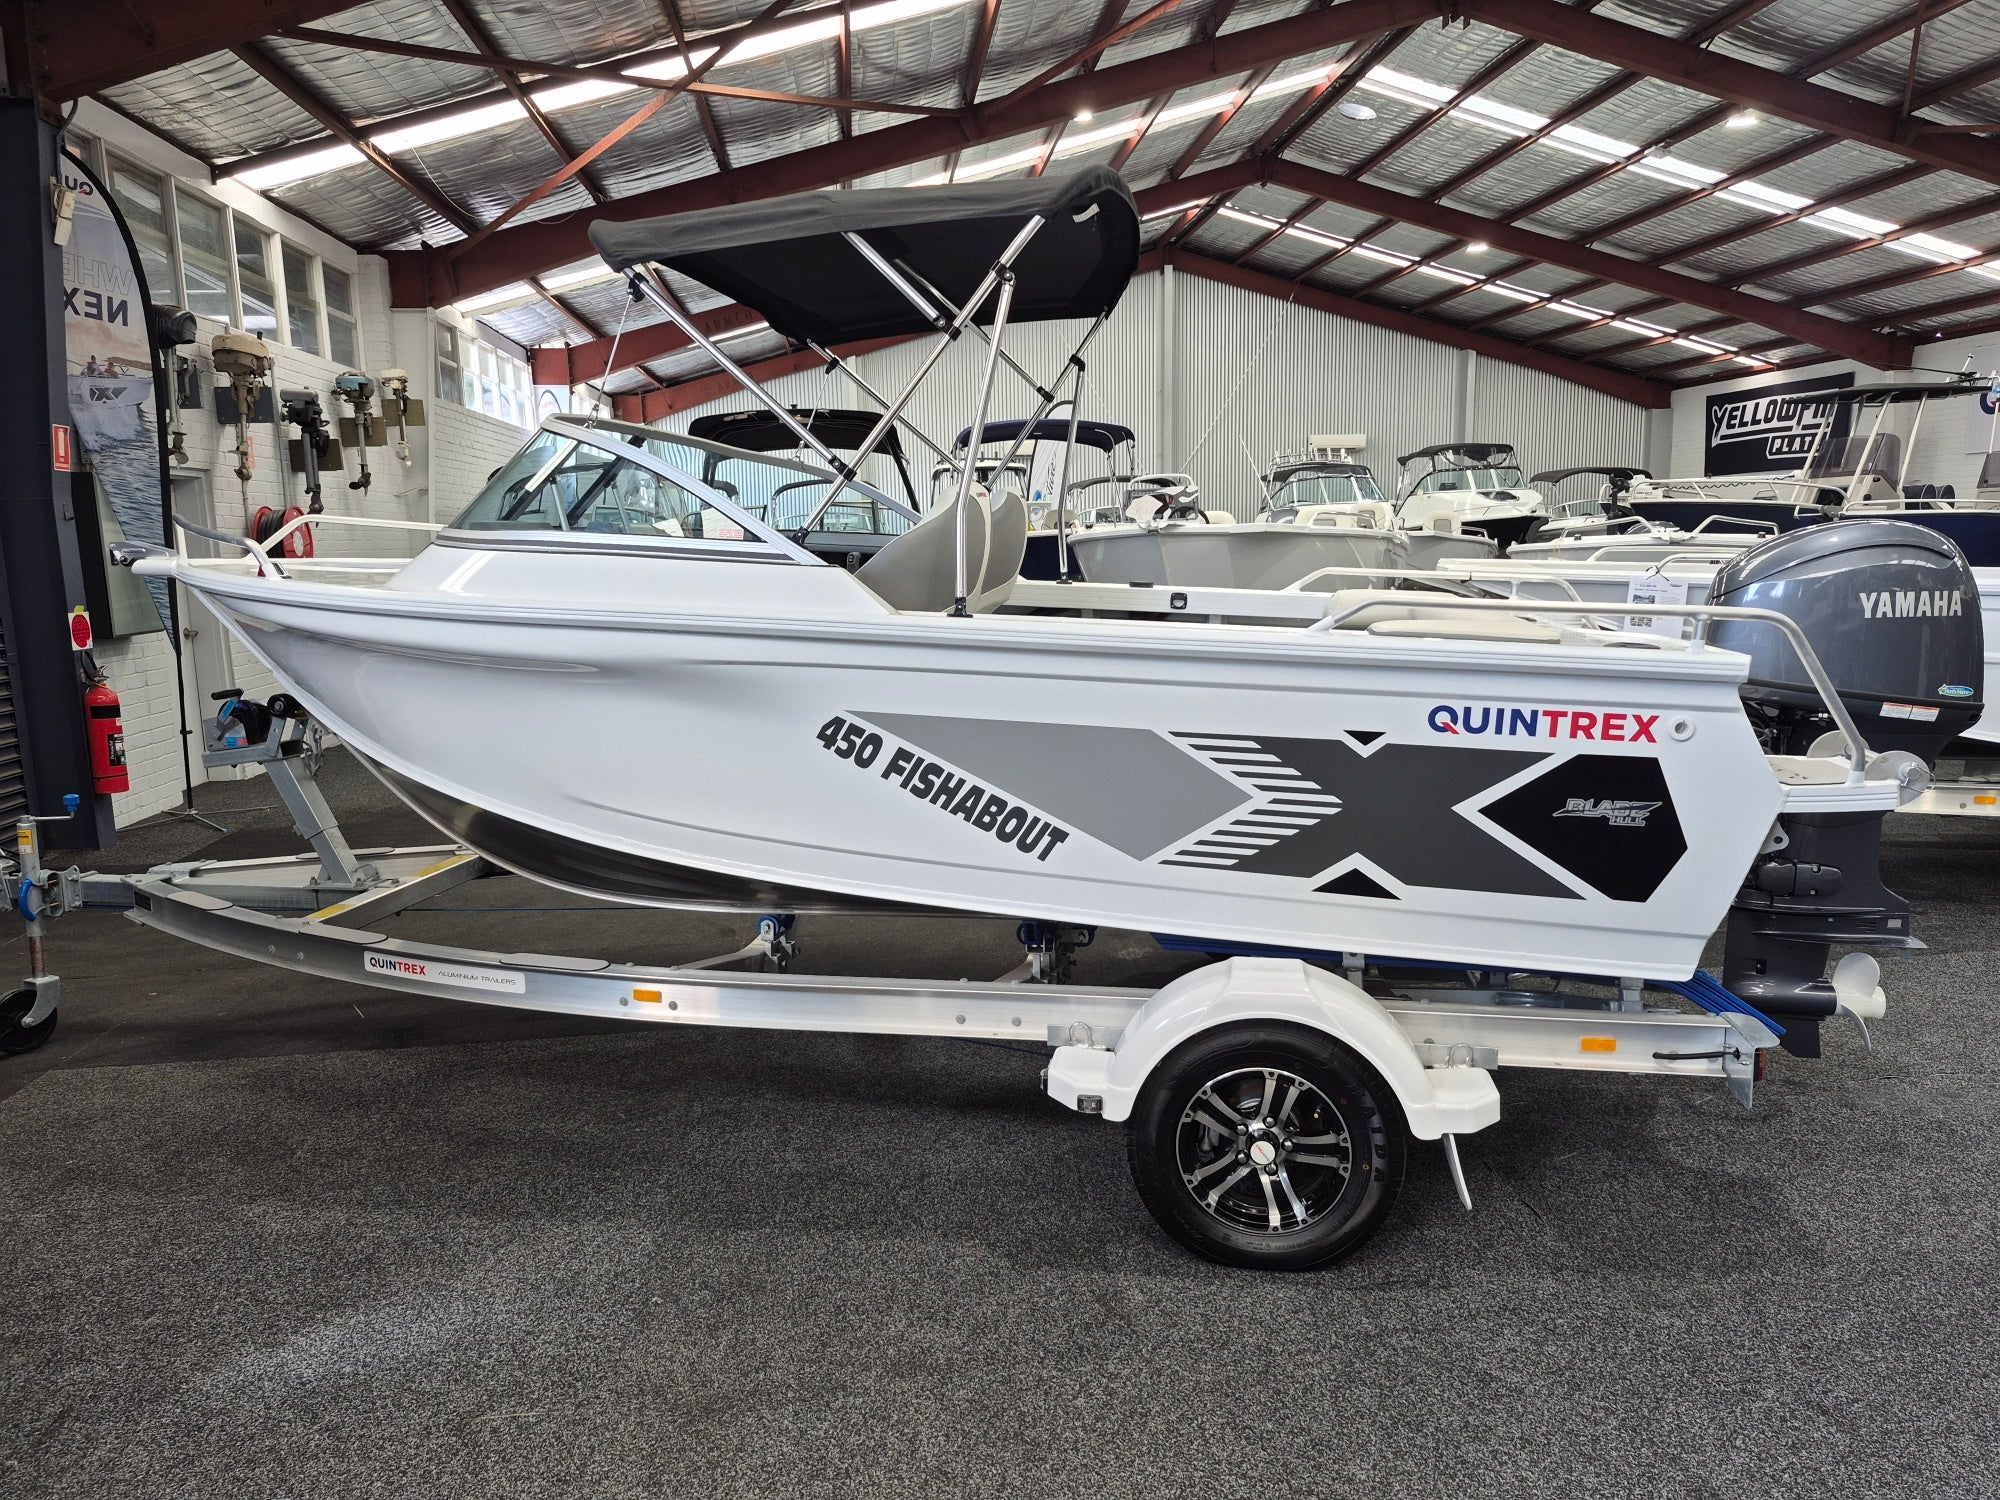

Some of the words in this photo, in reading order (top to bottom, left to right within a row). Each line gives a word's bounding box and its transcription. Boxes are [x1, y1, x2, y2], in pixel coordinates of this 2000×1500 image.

[1772, 436, 1820, 453] PLAT
[1860, 590, 1962, 619] YAMAHA
[1428, 705, 1660, 744] QUINTREX
[816, 715, 884, 769] 450
[880, 746, 1070, 862] FISHABOUT
[1554, 798, 1662, 817] BLADE
[369, 956, 427, 976] QUINTREX
[438, 969, 479, 981] ALUMINIUM
[480, 975, 516, 986] TRAILERS
